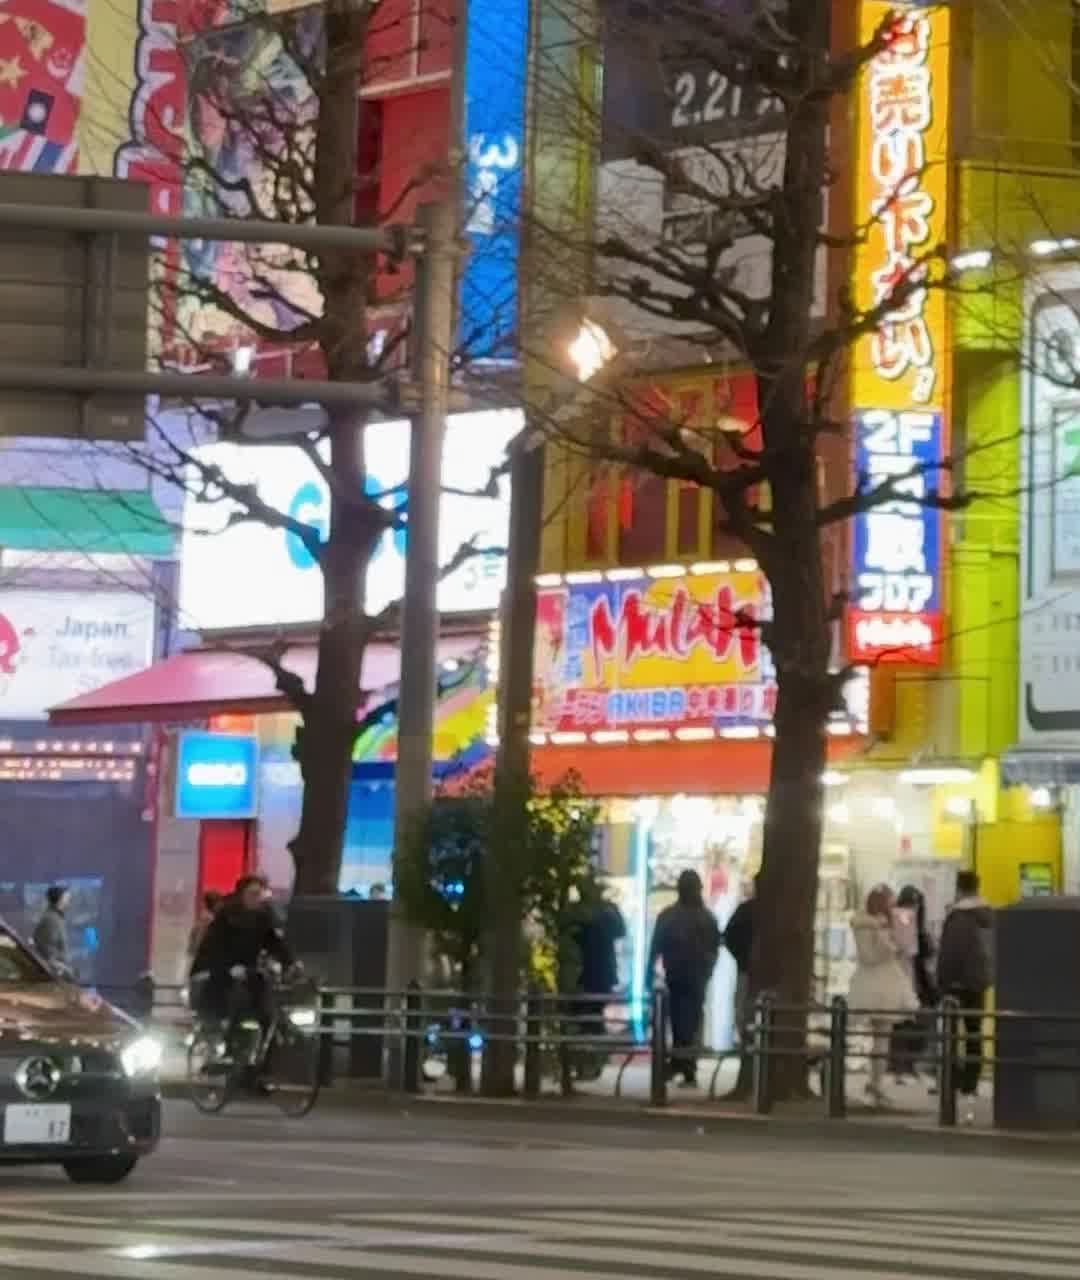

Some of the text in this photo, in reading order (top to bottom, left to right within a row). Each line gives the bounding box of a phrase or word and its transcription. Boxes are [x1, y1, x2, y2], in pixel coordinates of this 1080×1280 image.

[861, 410, 935, 454] 2F
[57, 616, 129, 640] Japan
[592, 583, 758, 685] Mulan
